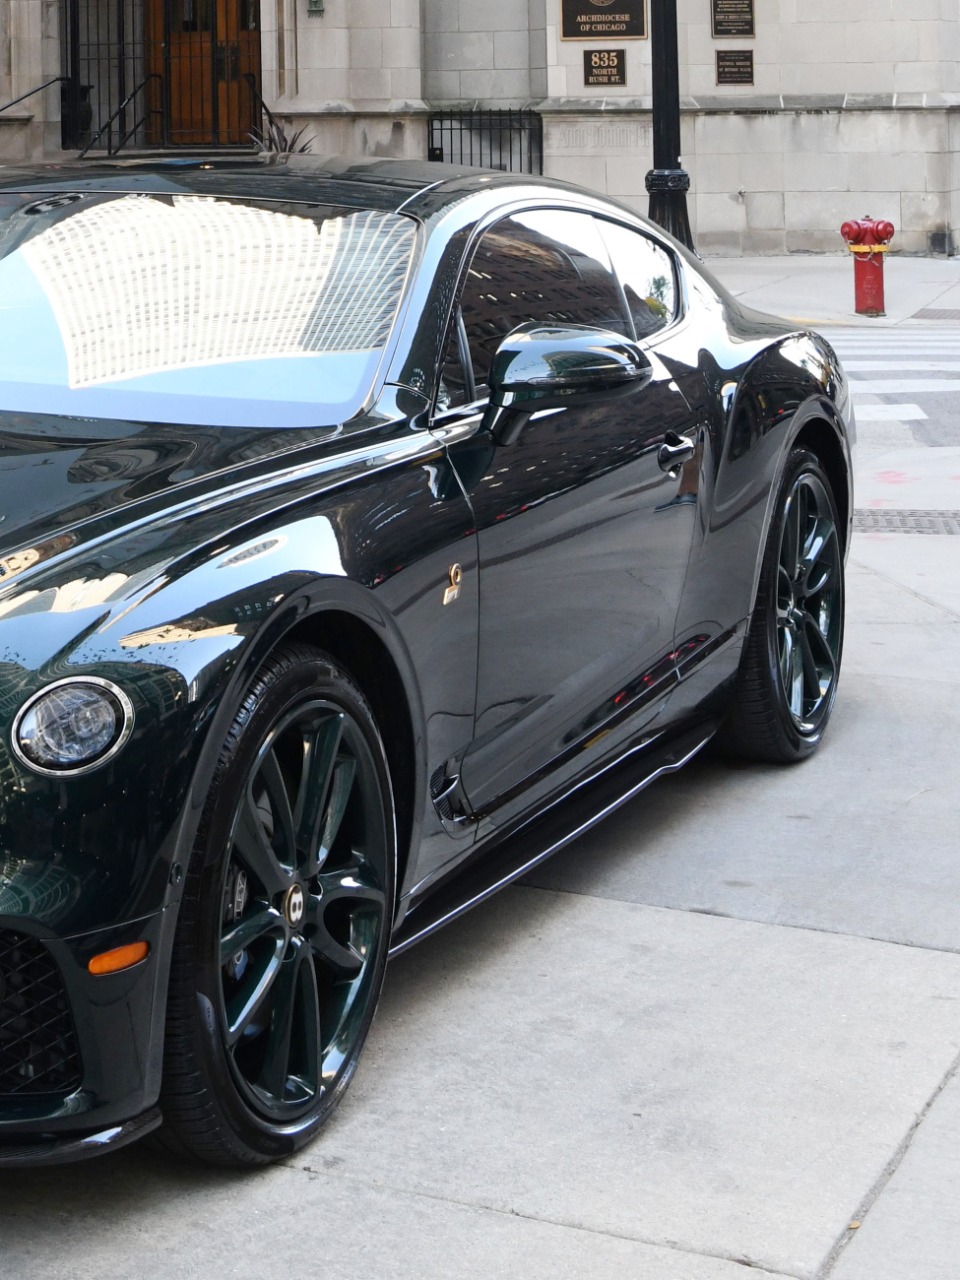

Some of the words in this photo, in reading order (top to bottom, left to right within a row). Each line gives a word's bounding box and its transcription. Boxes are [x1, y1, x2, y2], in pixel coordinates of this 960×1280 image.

[576, 14, 631, 23] ARCHDIOCESE
[580, 23, 591, 32] OF
[591, 23, 626, 31] CHICAGO
[591, 51, 618, 67] 835
[611, 75, 621, 83] ST.
